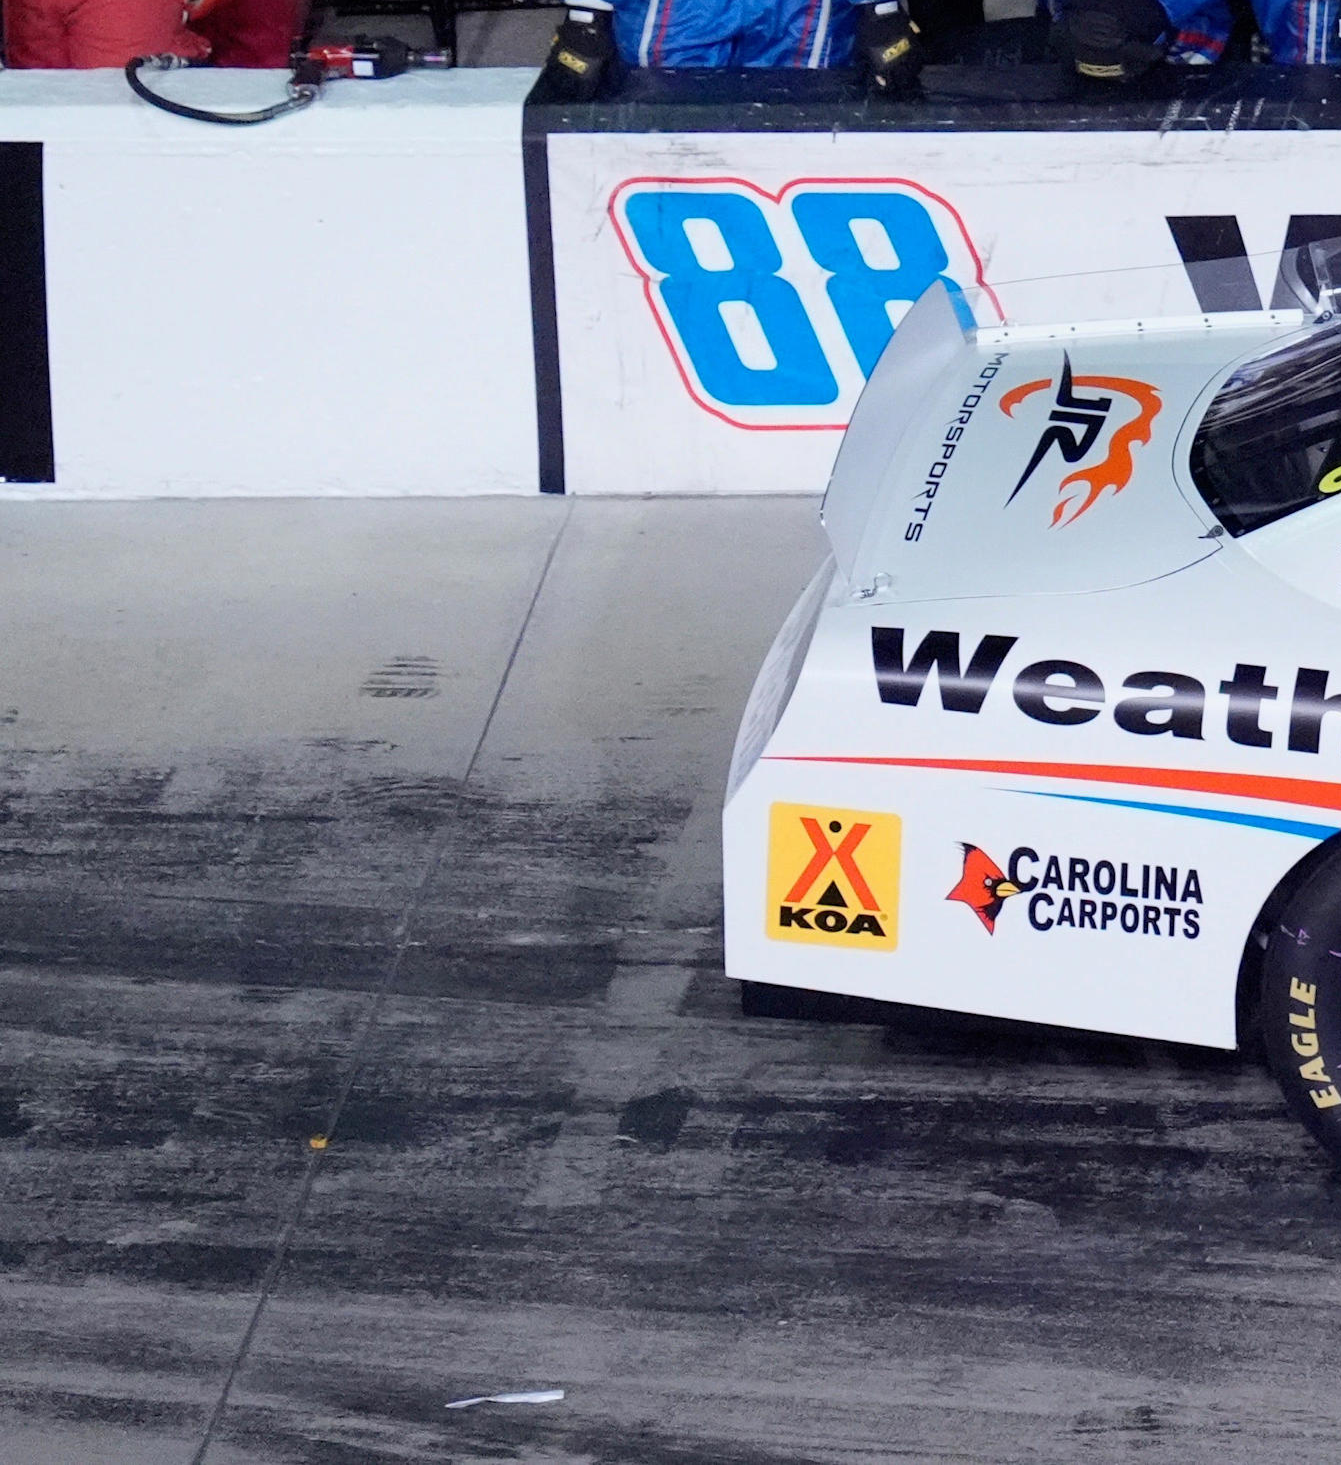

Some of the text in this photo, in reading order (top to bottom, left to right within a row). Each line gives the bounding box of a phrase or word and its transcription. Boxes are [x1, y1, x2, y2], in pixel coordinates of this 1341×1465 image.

[608, 177, 1005, 431] 88
[904, 351, 1011, 544] MOTORSPORTS
[1007, 846, 1205, 905] CAROLINA
[779, 905, 888, 938] KOA
[1027, 891, 1201, 940] CARPORTS
